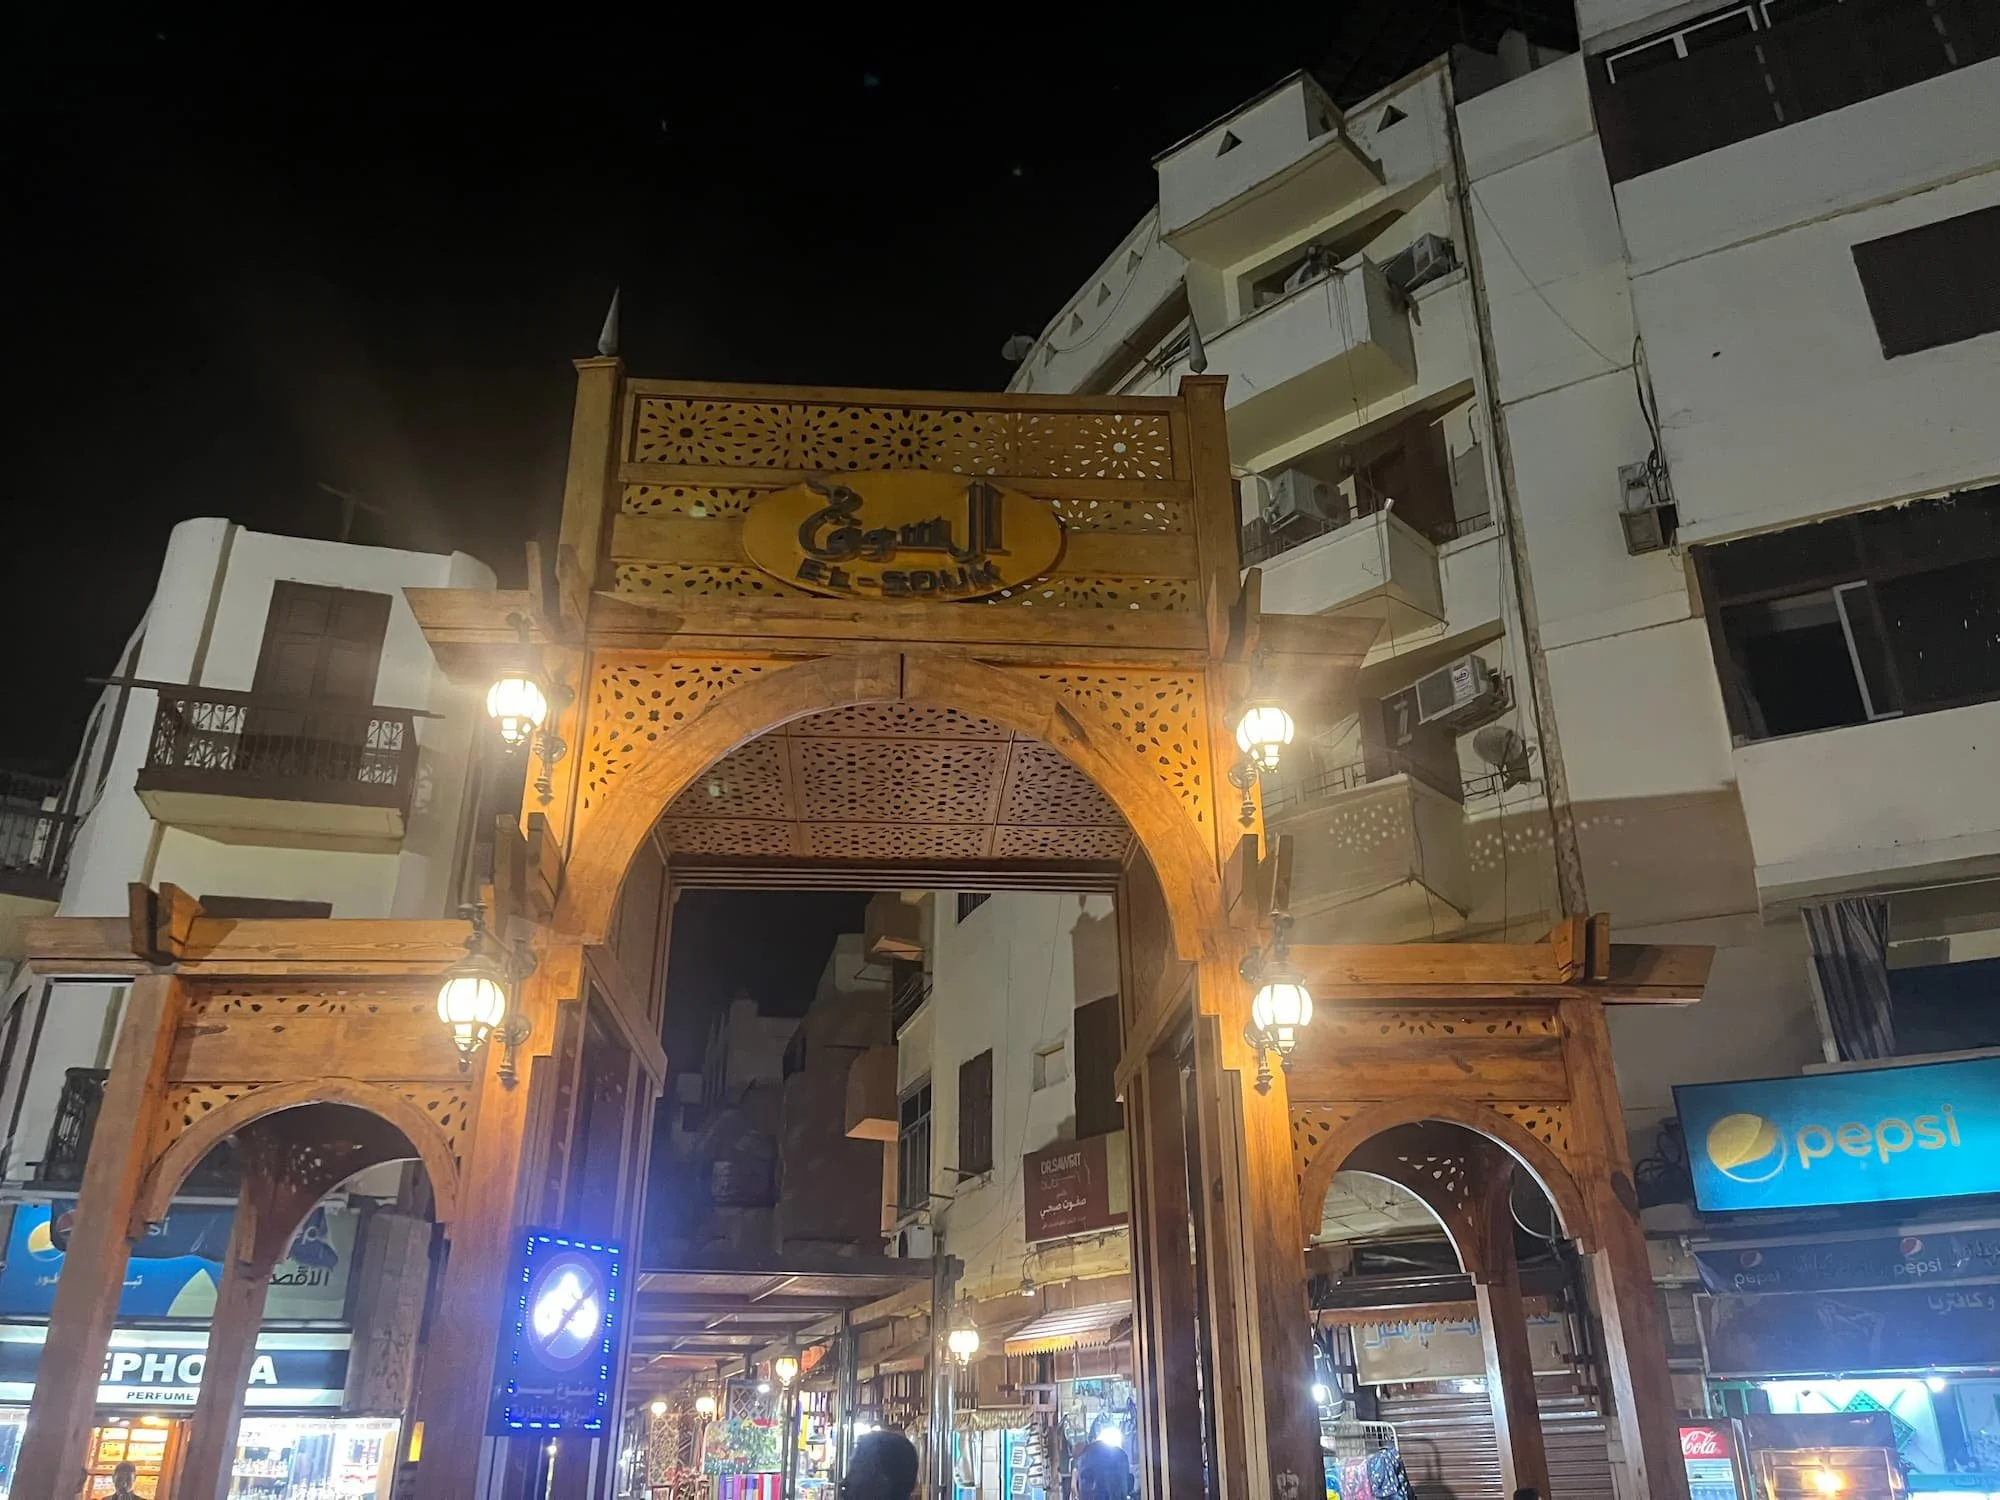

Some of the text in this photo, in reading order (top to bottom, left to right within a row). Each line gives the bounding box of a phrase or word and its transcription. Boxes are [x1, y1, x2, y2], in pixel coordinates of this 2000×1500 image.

[796, 556, 1007, 597] EL-SOUK
[1796, 1104, 1961, 1169] pepsi
[1893, 1256, 1942, 1277] pepsi
[101, 1352, 278, 1384] PHOA
